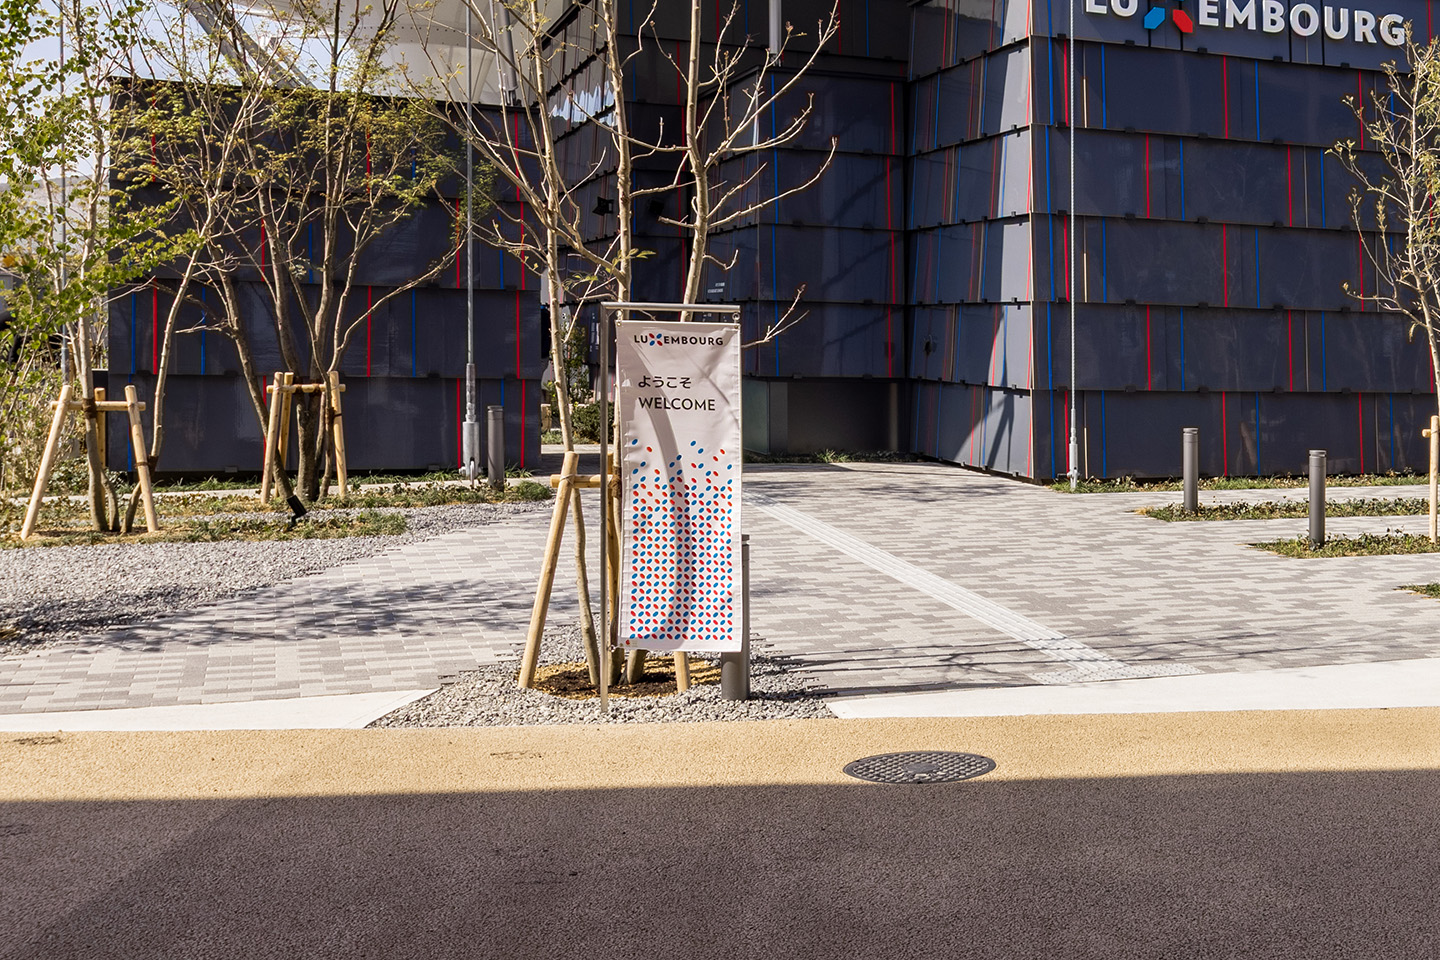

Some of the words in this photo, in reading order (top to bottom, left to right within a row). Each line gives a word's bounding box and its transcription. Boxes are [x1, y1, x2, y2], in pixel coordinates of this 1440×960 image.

[634, 333, 723, 346] LUXEMBOURG
[638, 375, 691, 389] ようこそ
[638, 397, 716, 411] WELCOME
